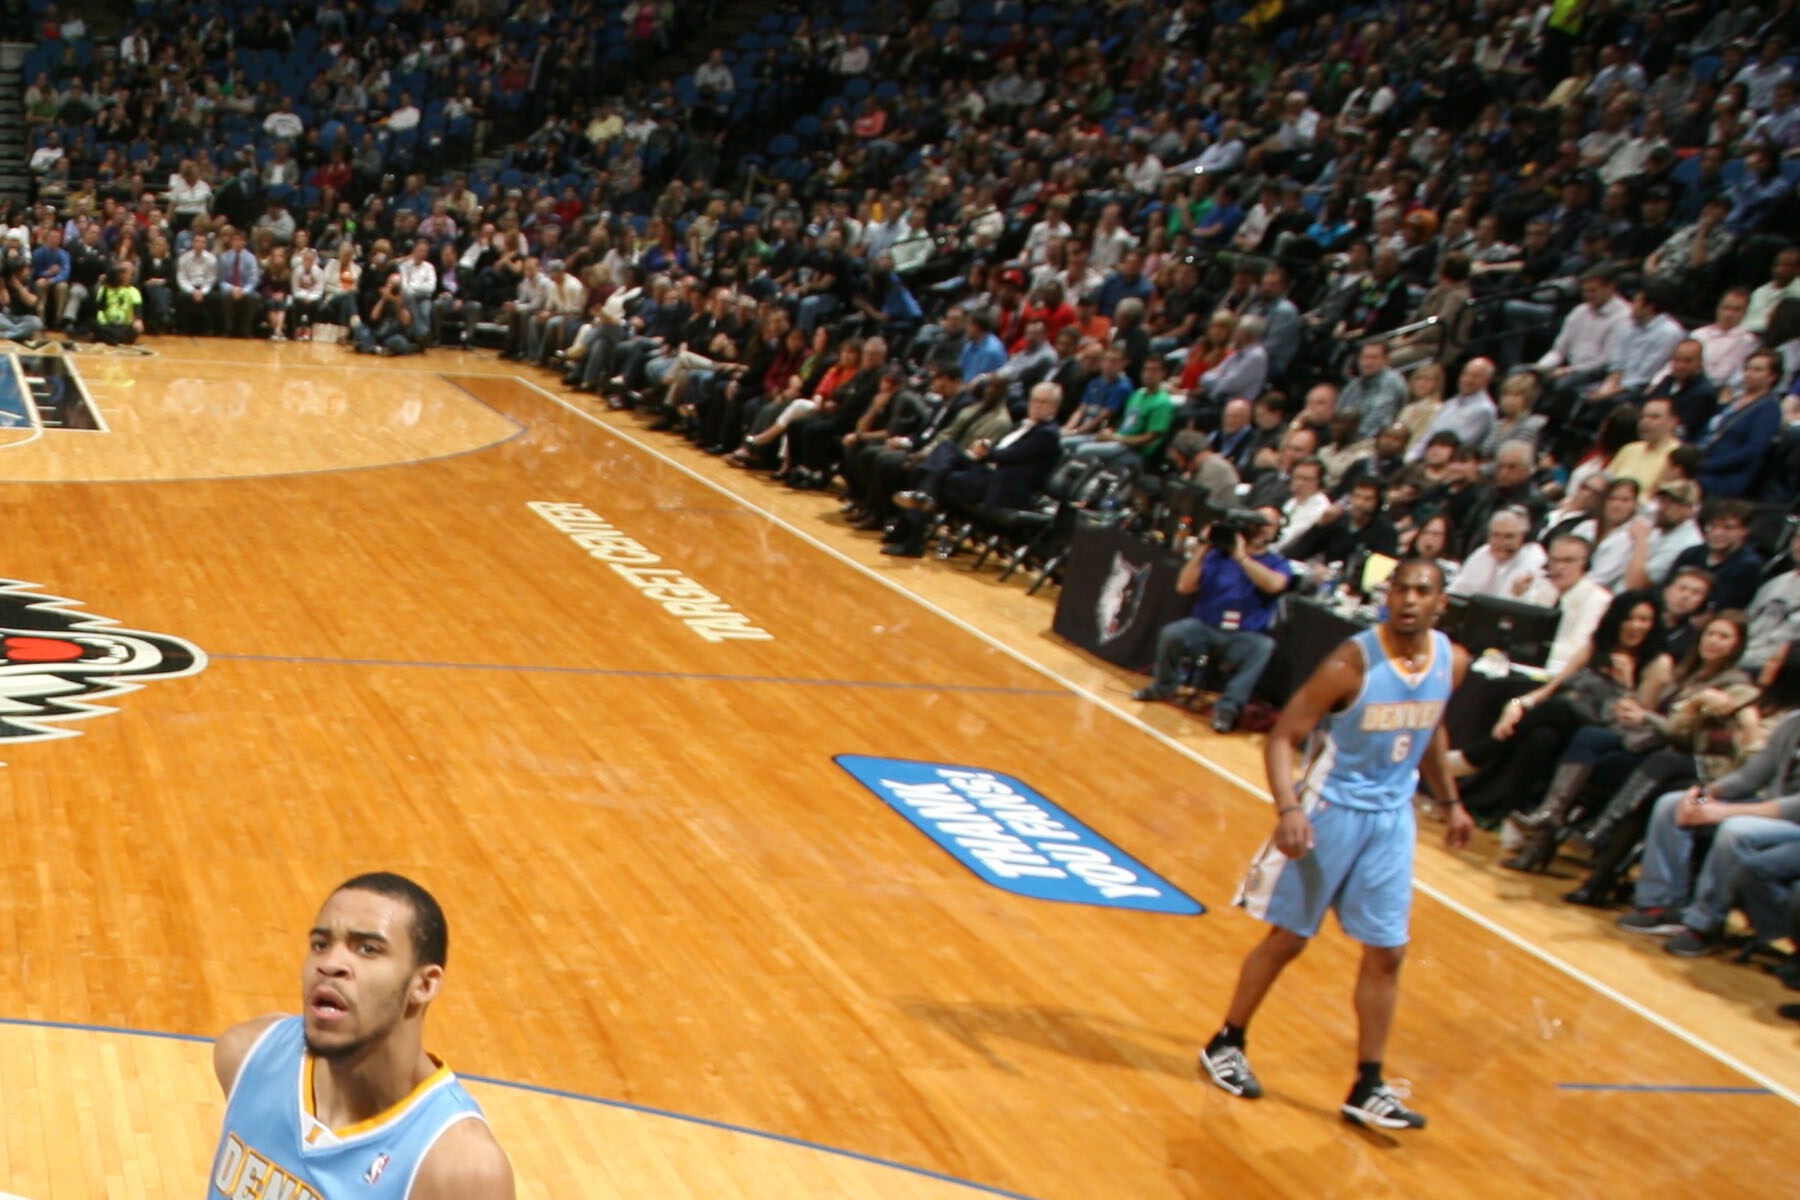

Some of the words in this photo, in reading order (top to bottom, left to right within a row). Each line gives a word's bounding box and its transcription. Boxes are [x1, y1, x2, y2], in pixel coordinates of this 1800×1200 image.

[525, 500, 662, 564] CENTER
[609, 563, 775, 643] TARGET
[1391, 733, 1413, 763] 6
[879, 778, 1068, 879] THANK
[935, 768, 1080, 841] FANS!
[1036, 841, 1162, 898] YOU
